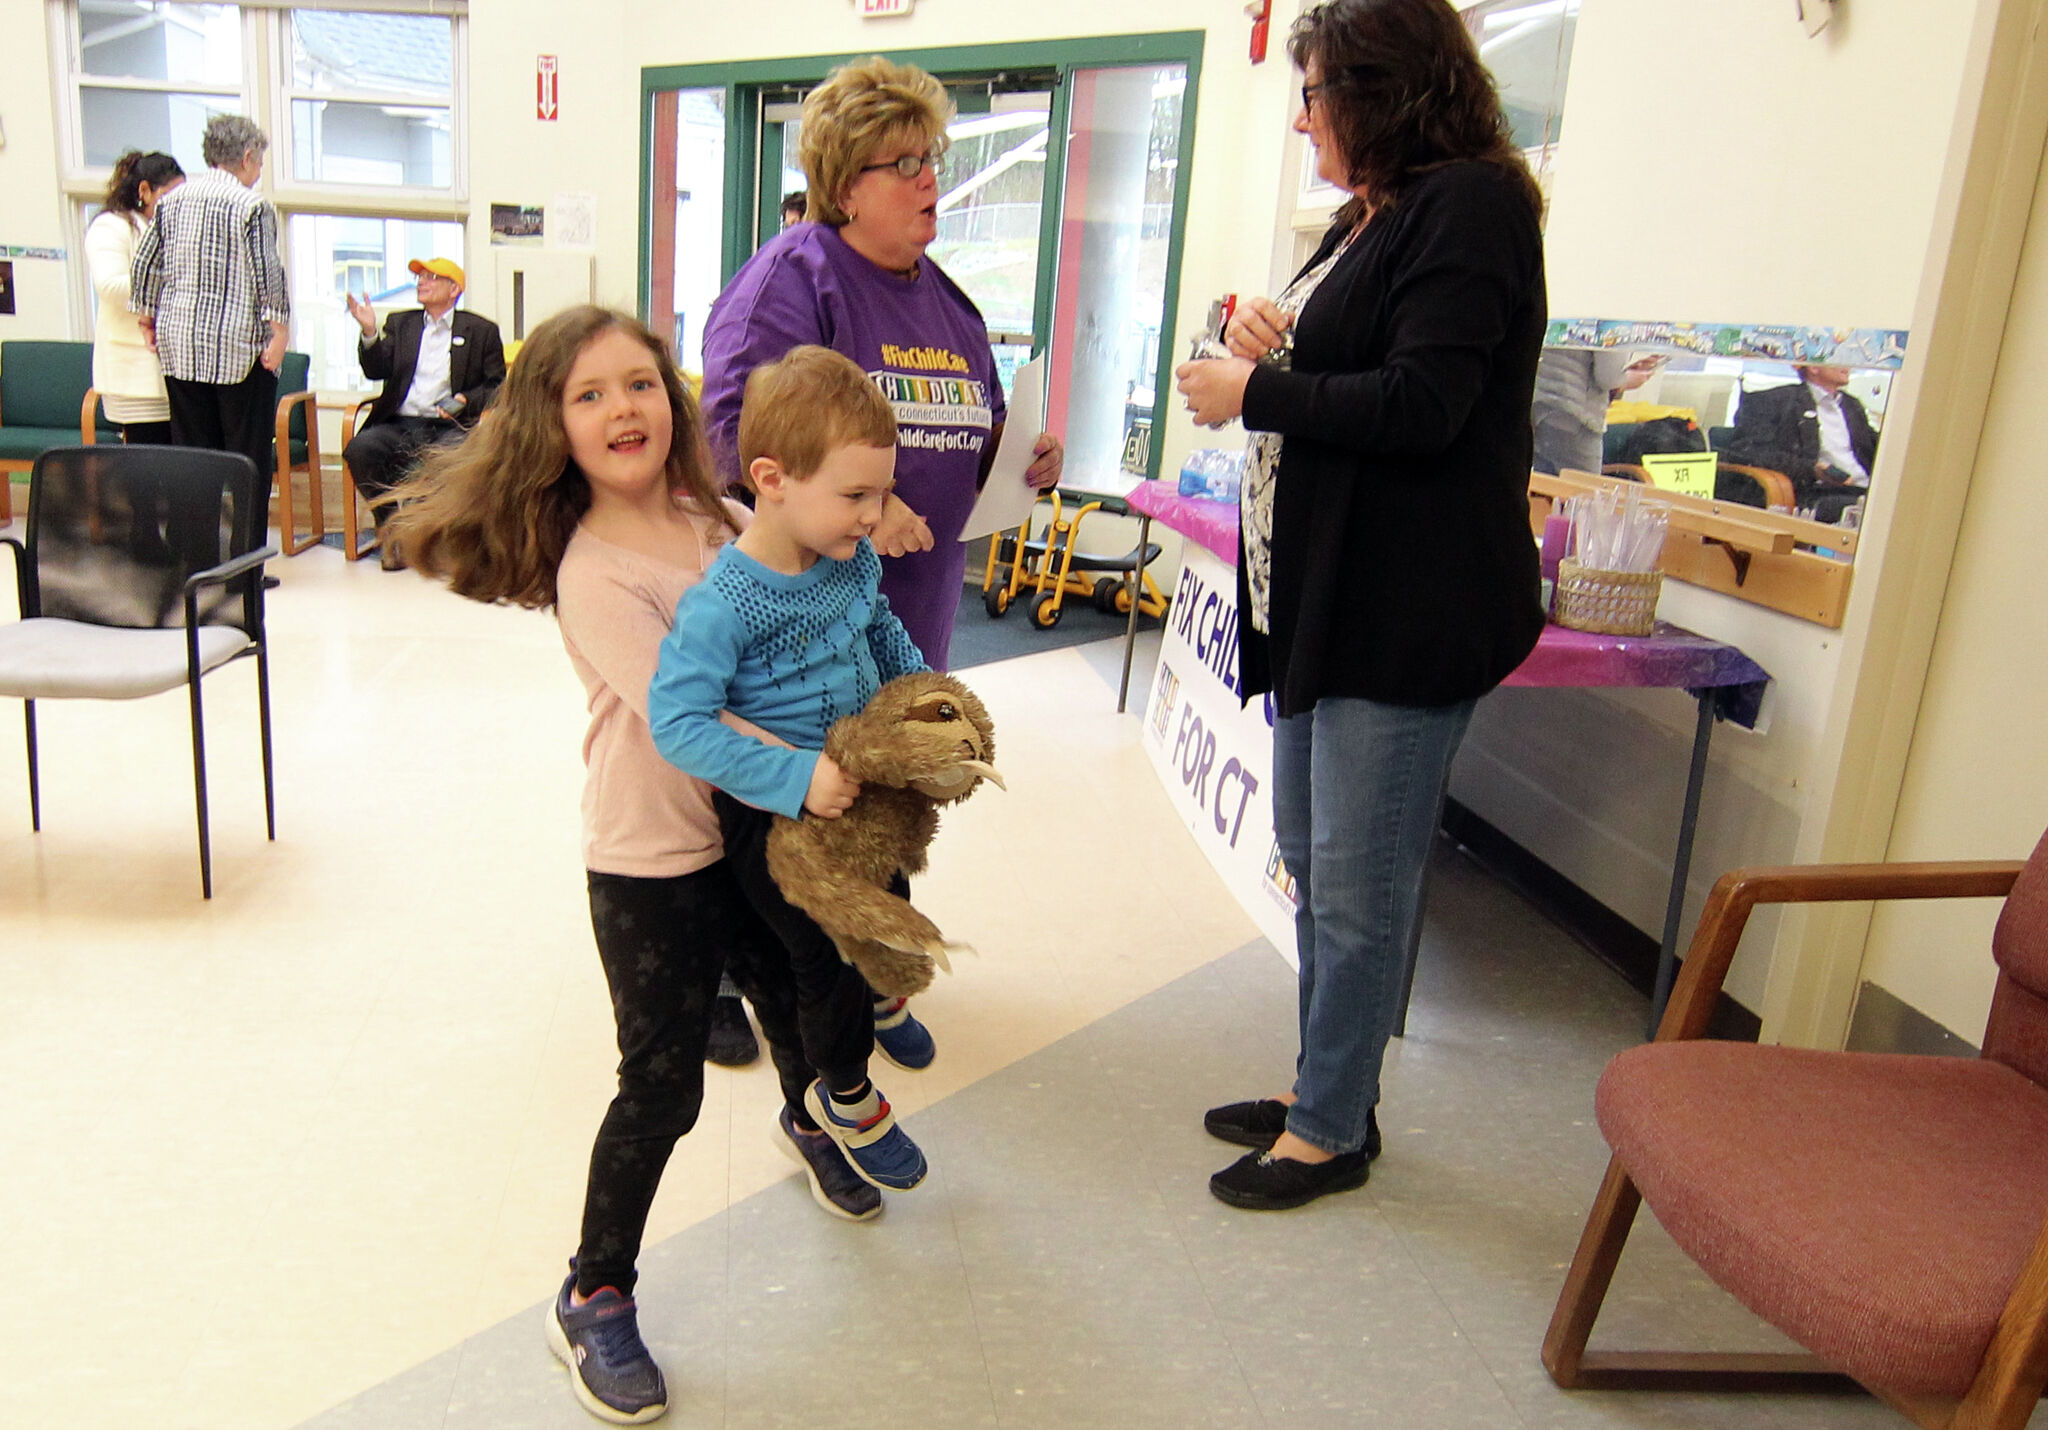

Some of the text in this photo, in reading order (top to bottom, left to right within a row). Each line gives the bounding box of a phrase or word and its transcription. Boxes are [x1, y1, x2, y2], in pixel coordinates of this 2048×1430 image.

[1172, 566, 1242, 698] FIX CHIL
[1172, 701, 1259, 850] FOR CT
